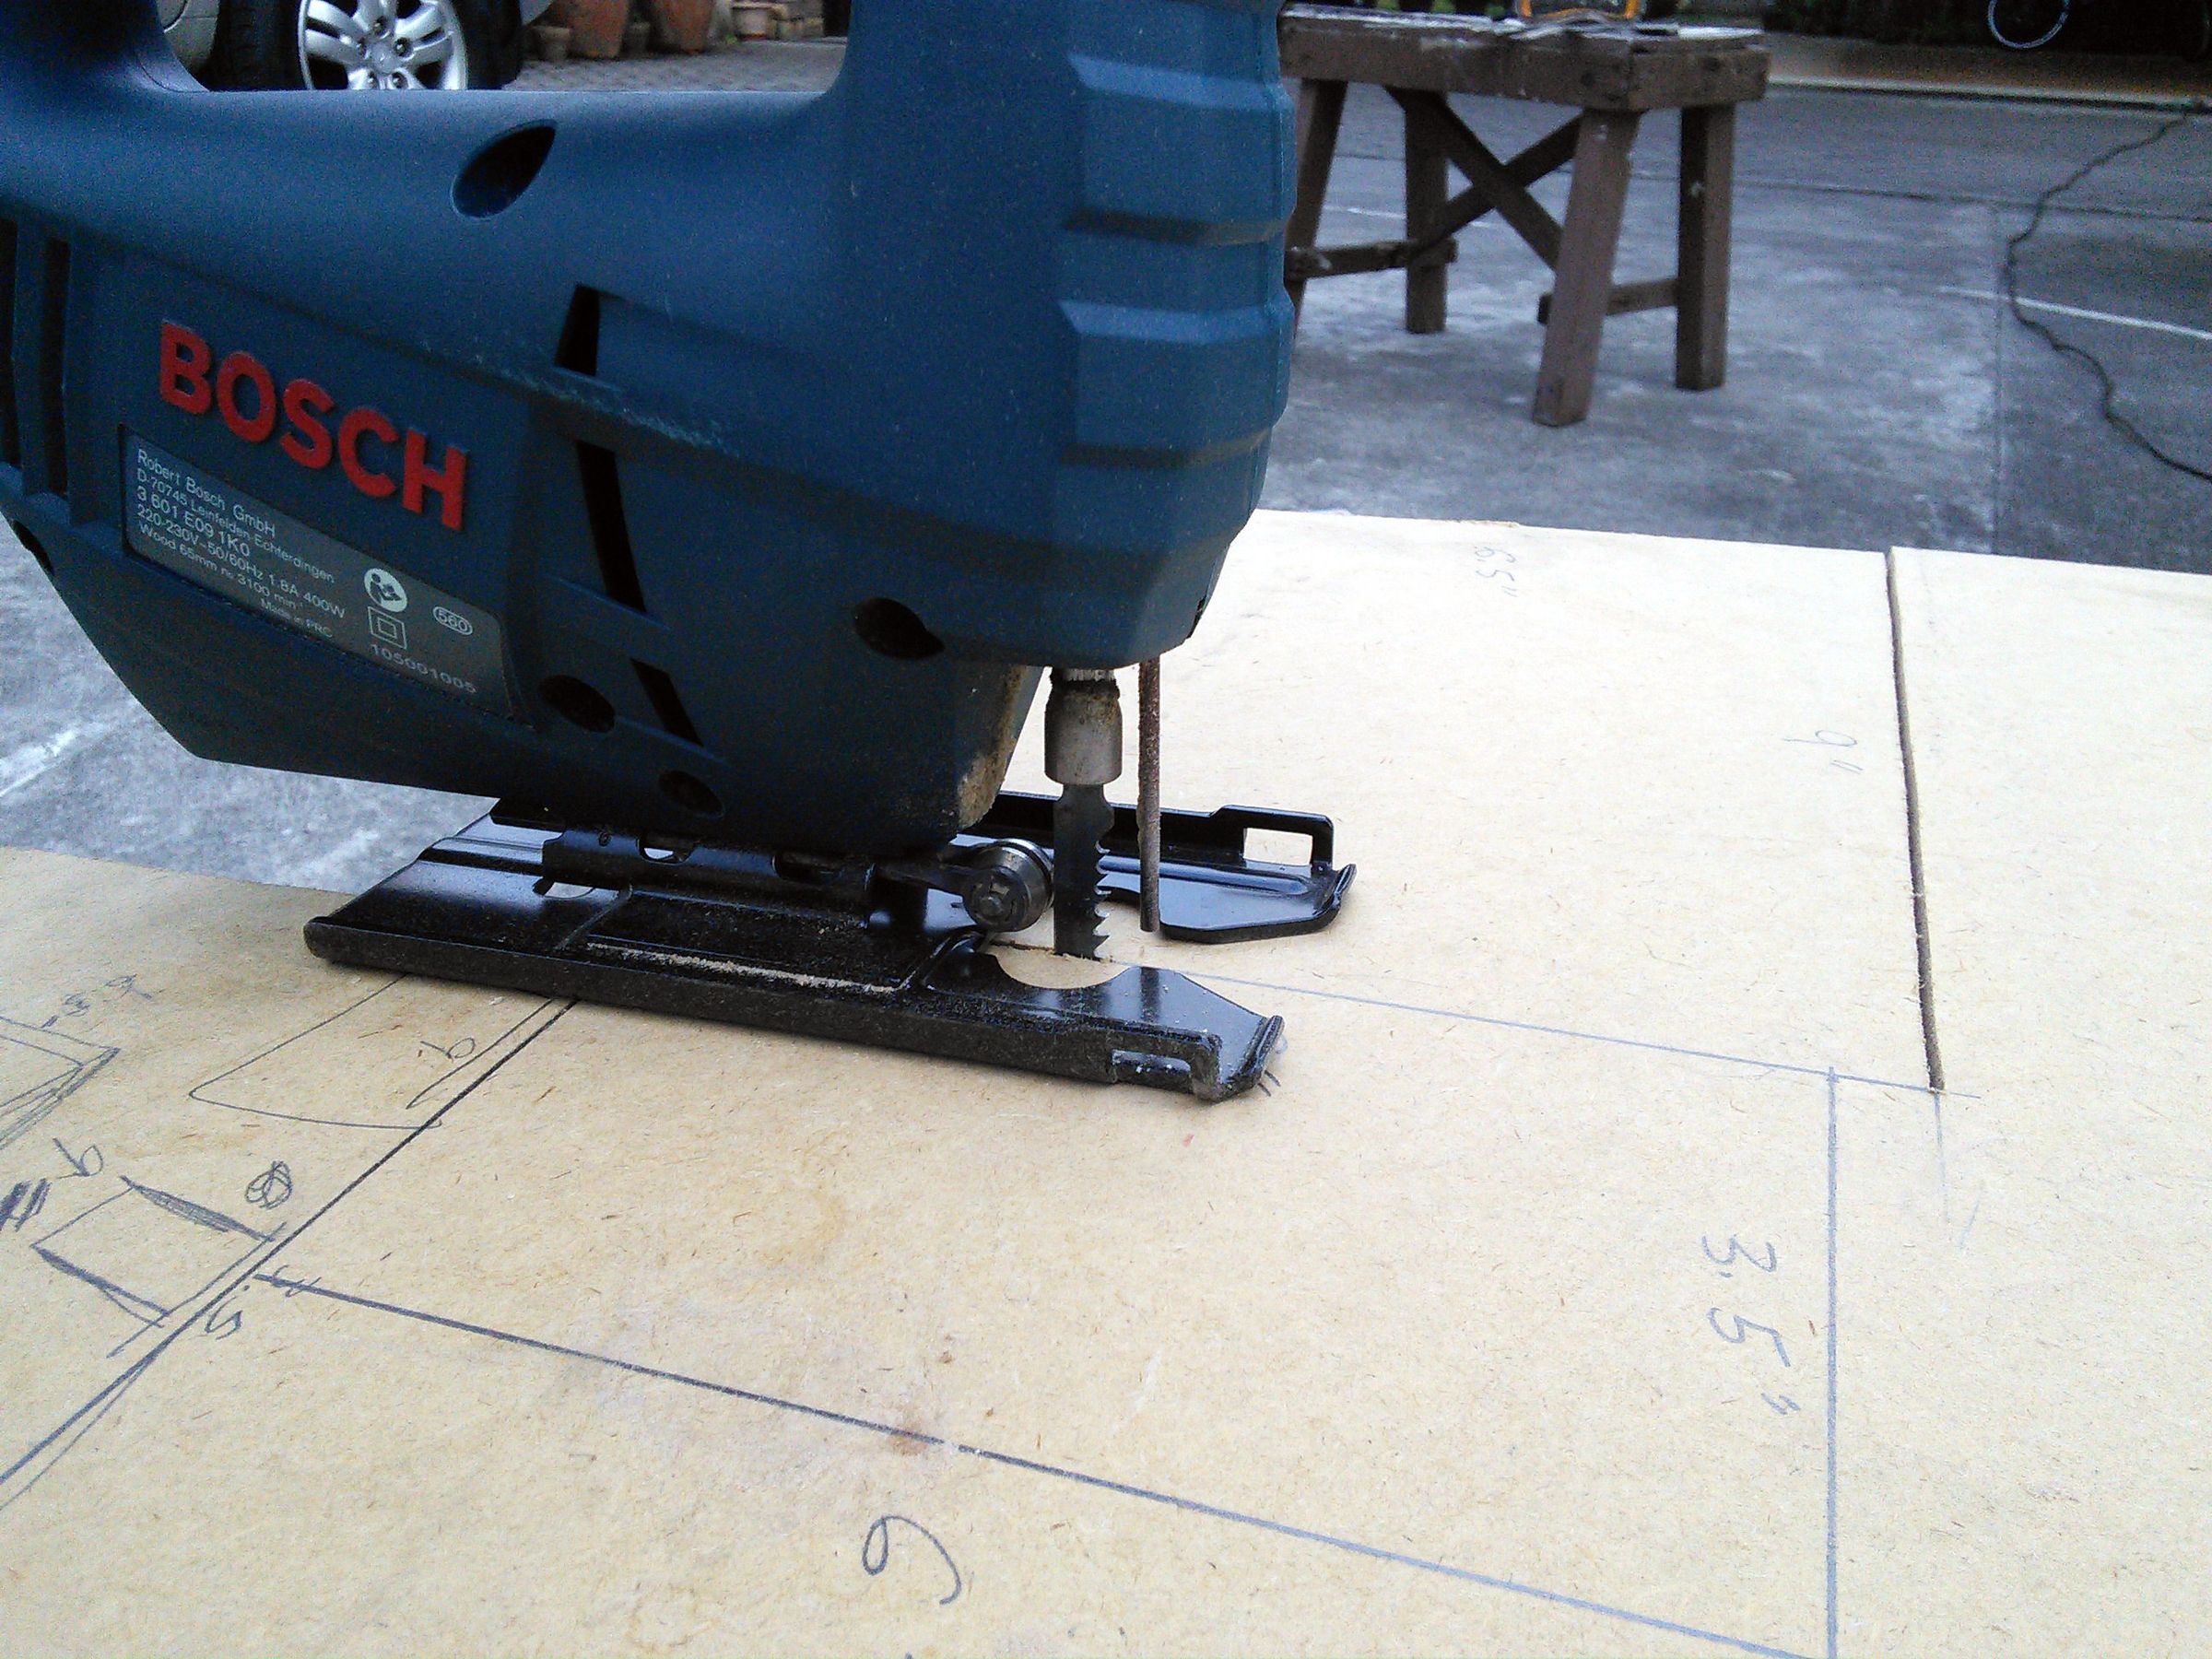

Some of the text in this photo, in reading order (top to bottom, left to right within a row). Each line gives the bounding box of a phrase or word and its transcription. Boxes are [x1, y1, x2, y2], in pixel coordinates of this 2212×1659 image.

[159, 318, 468, 532] BOSCH
[137, 486, 147, 501] 3
[151, 493, 178, 518] 601
[138, 448, 276, 537] Robert Bosch GmbH
[139, 519, 176, 550] Wood
[303, 592, 346, 618] 400W
